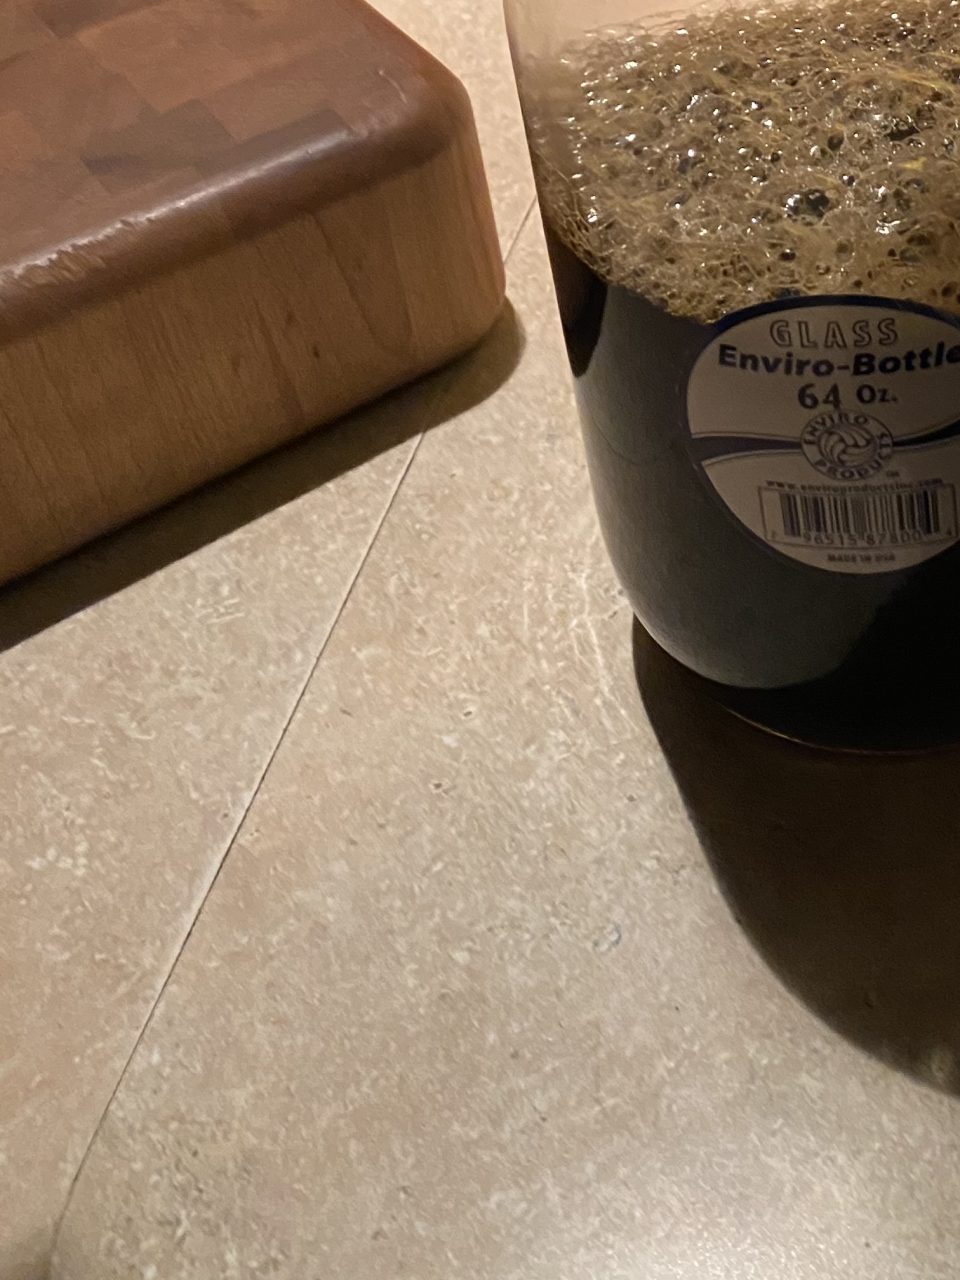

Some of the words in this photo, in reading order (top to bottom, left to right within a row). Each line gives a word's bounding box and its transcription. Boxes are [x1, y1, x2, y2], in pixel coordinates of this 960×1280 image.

[769, 318, 899, 349] GLASS
[797, 383, 842, 410] 64
[856, 384, 898, 405] Oz.
[804, 412, 869, 445] ENVIRO
